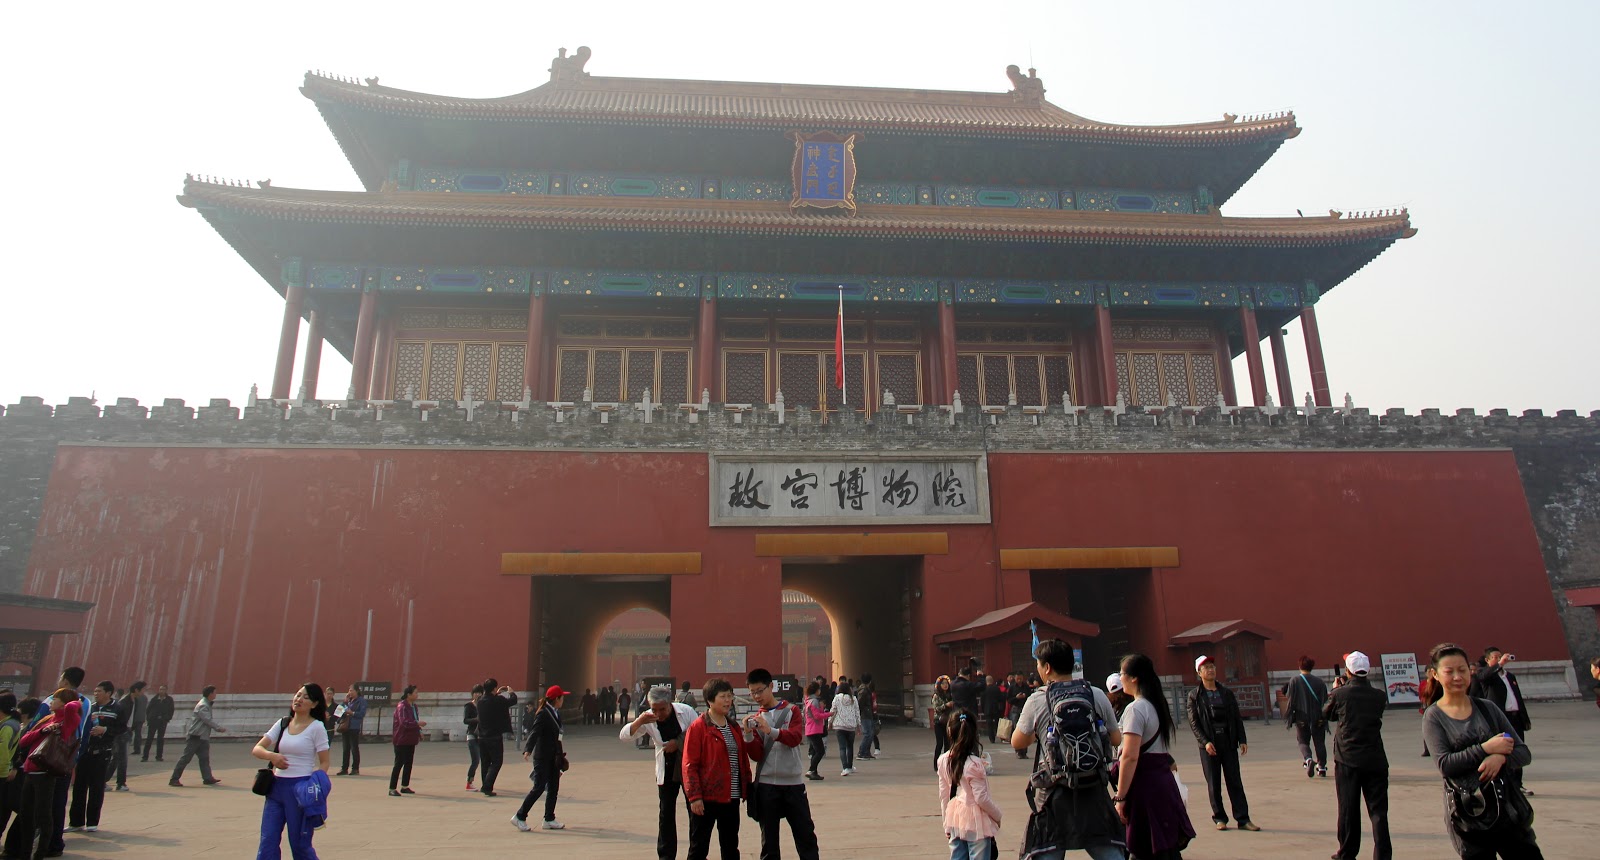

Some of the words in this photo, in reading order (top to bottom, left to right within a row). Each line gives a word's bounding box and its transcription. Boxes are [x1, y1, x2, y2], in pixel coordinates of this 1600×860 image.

[728, 467, 967, 511] 故宫博物院
